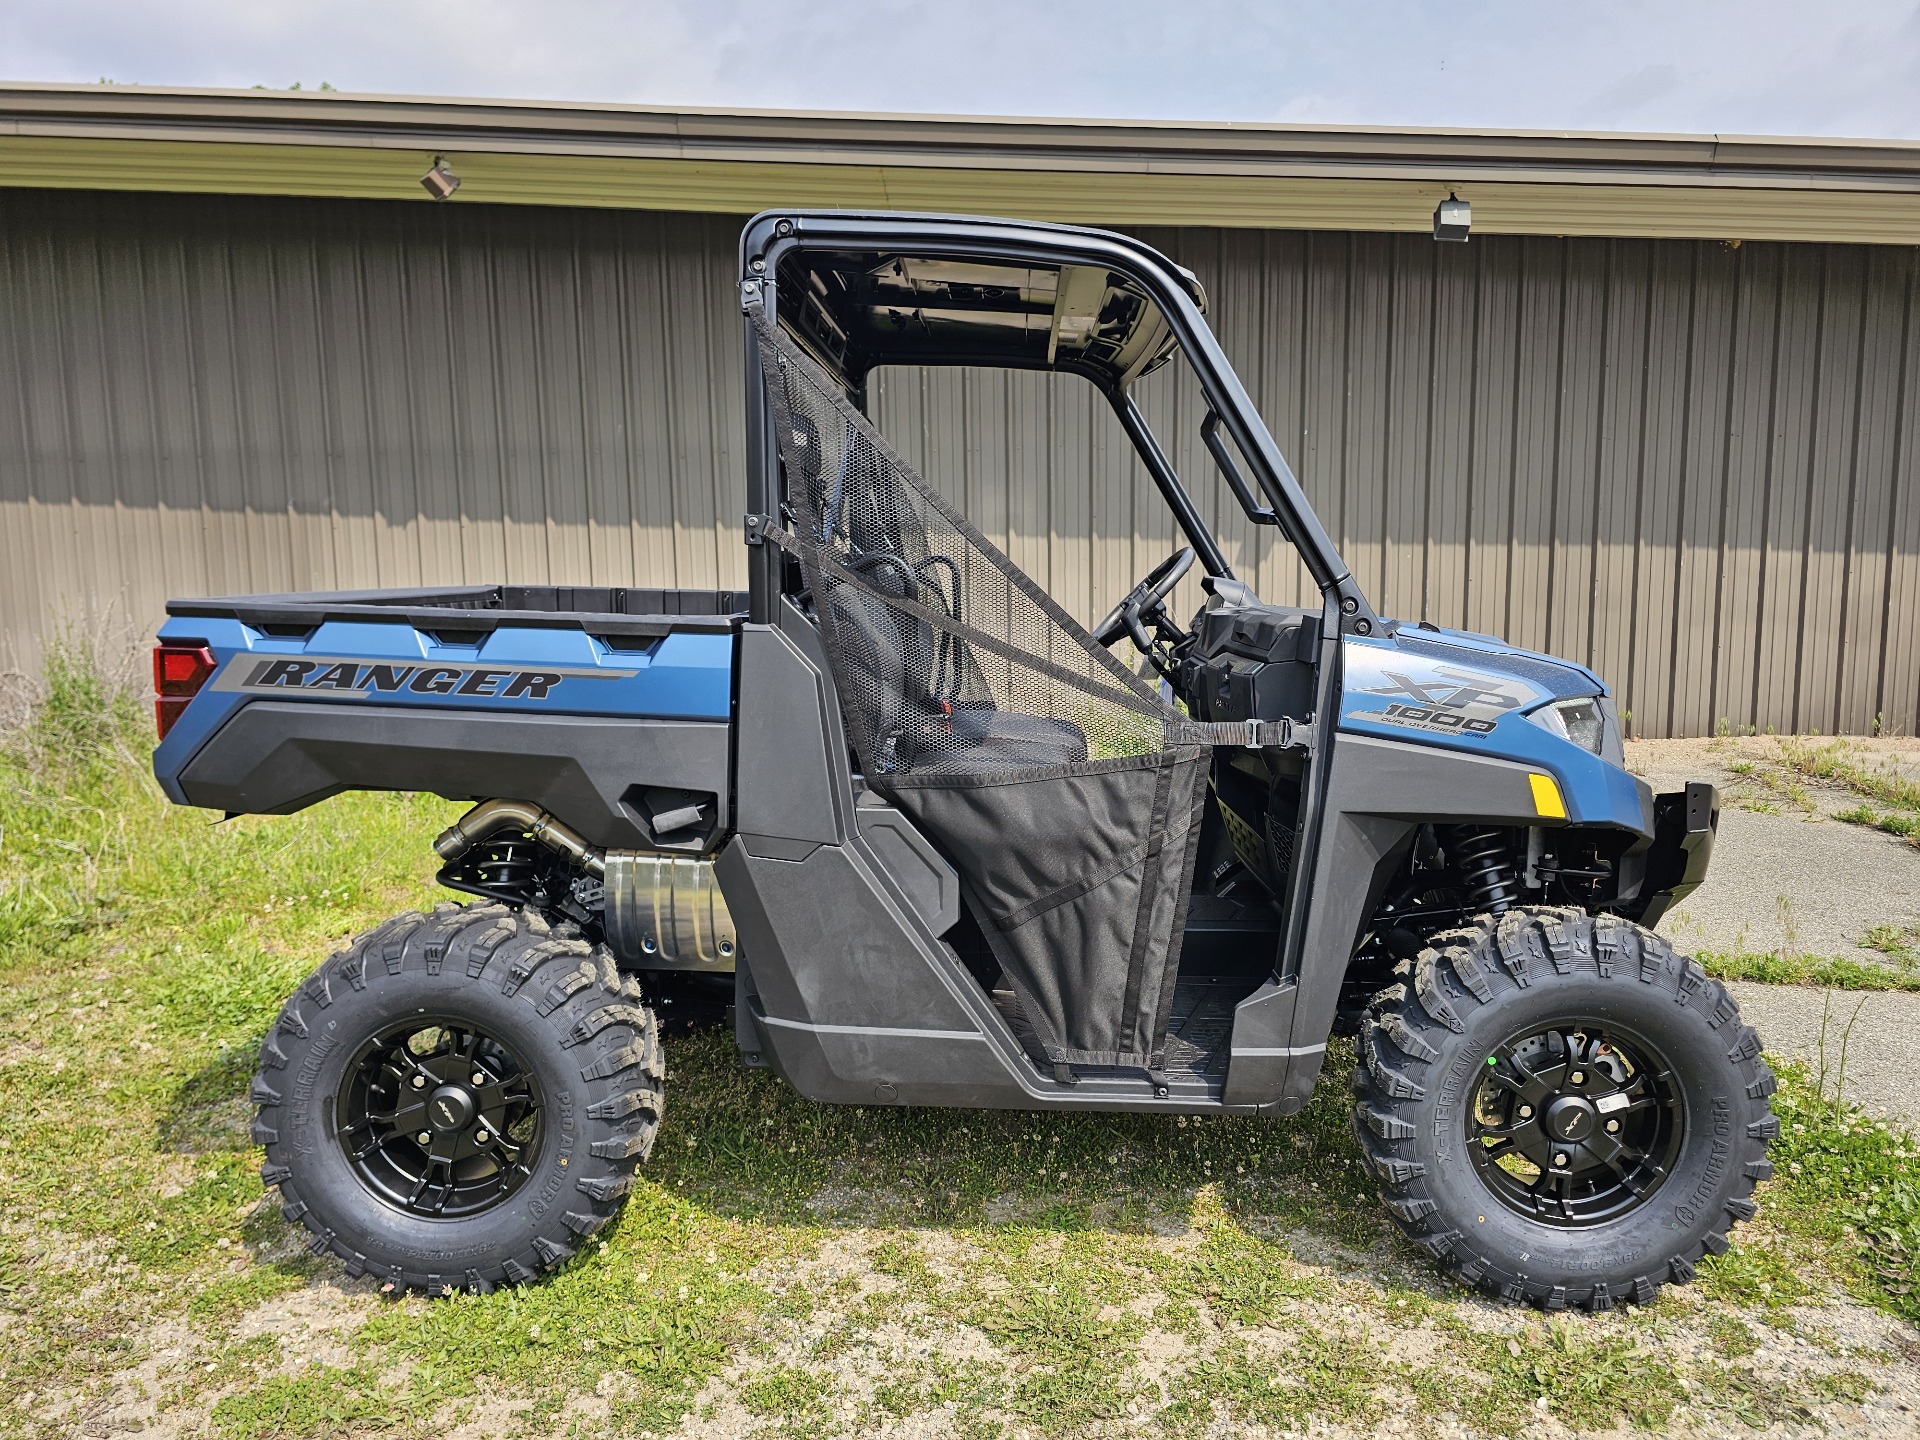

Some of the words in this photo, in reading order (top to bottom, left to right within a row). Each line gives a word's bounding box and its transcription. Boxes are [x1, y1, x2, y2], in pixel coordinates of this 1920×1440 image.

[257, 659, 562, 699] RANGER
[1353, 670, 1523, 709] XP
[1381, 717, 1407, 726] DUAL
[1409, 722, 1463, 735] OVERHEAD
[1464, 732, 1488, 740] CAM
[1384, 703, 1498, 733] 1000
[290, 1031, 339, 1158] X-TERRAIN
[557, 1090, 575, 1131] PRO
[1434, 1038, 1485, 1165] X-TERRAIN
[1711, 1095, 1730, 1137] PRO
[541, 1133, 575, 1203] ARMOR
[1688, 1139, 1729, 1210] ARMOR
